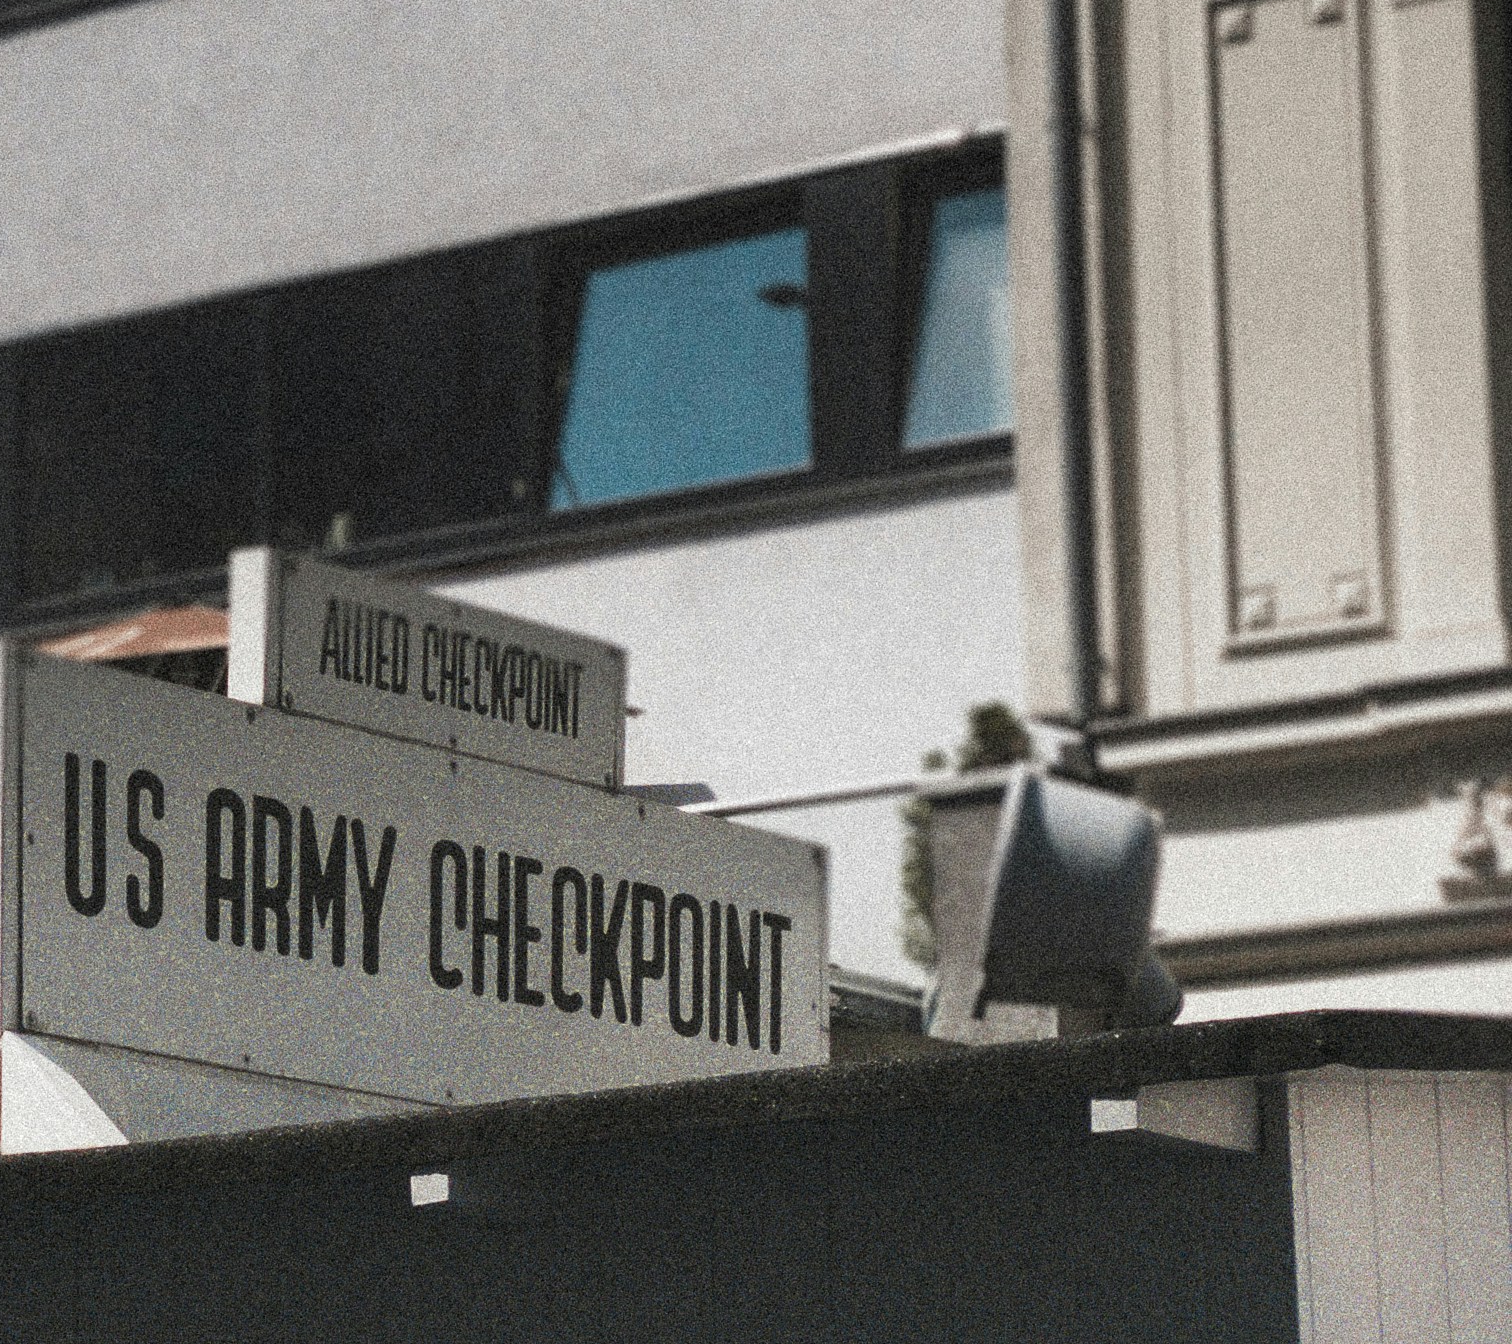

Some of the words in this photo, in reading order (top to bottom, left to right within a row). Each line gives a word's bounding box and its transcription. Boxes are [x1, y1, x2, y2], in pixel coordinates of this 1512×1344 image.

[320, 597, 409, 696] ALLIED
[421, 622, 584, 740] CHECKPOINT
[204, 786, 398, 976] ARMY
[427, 838, 792, 1056] CHECKPOINT
